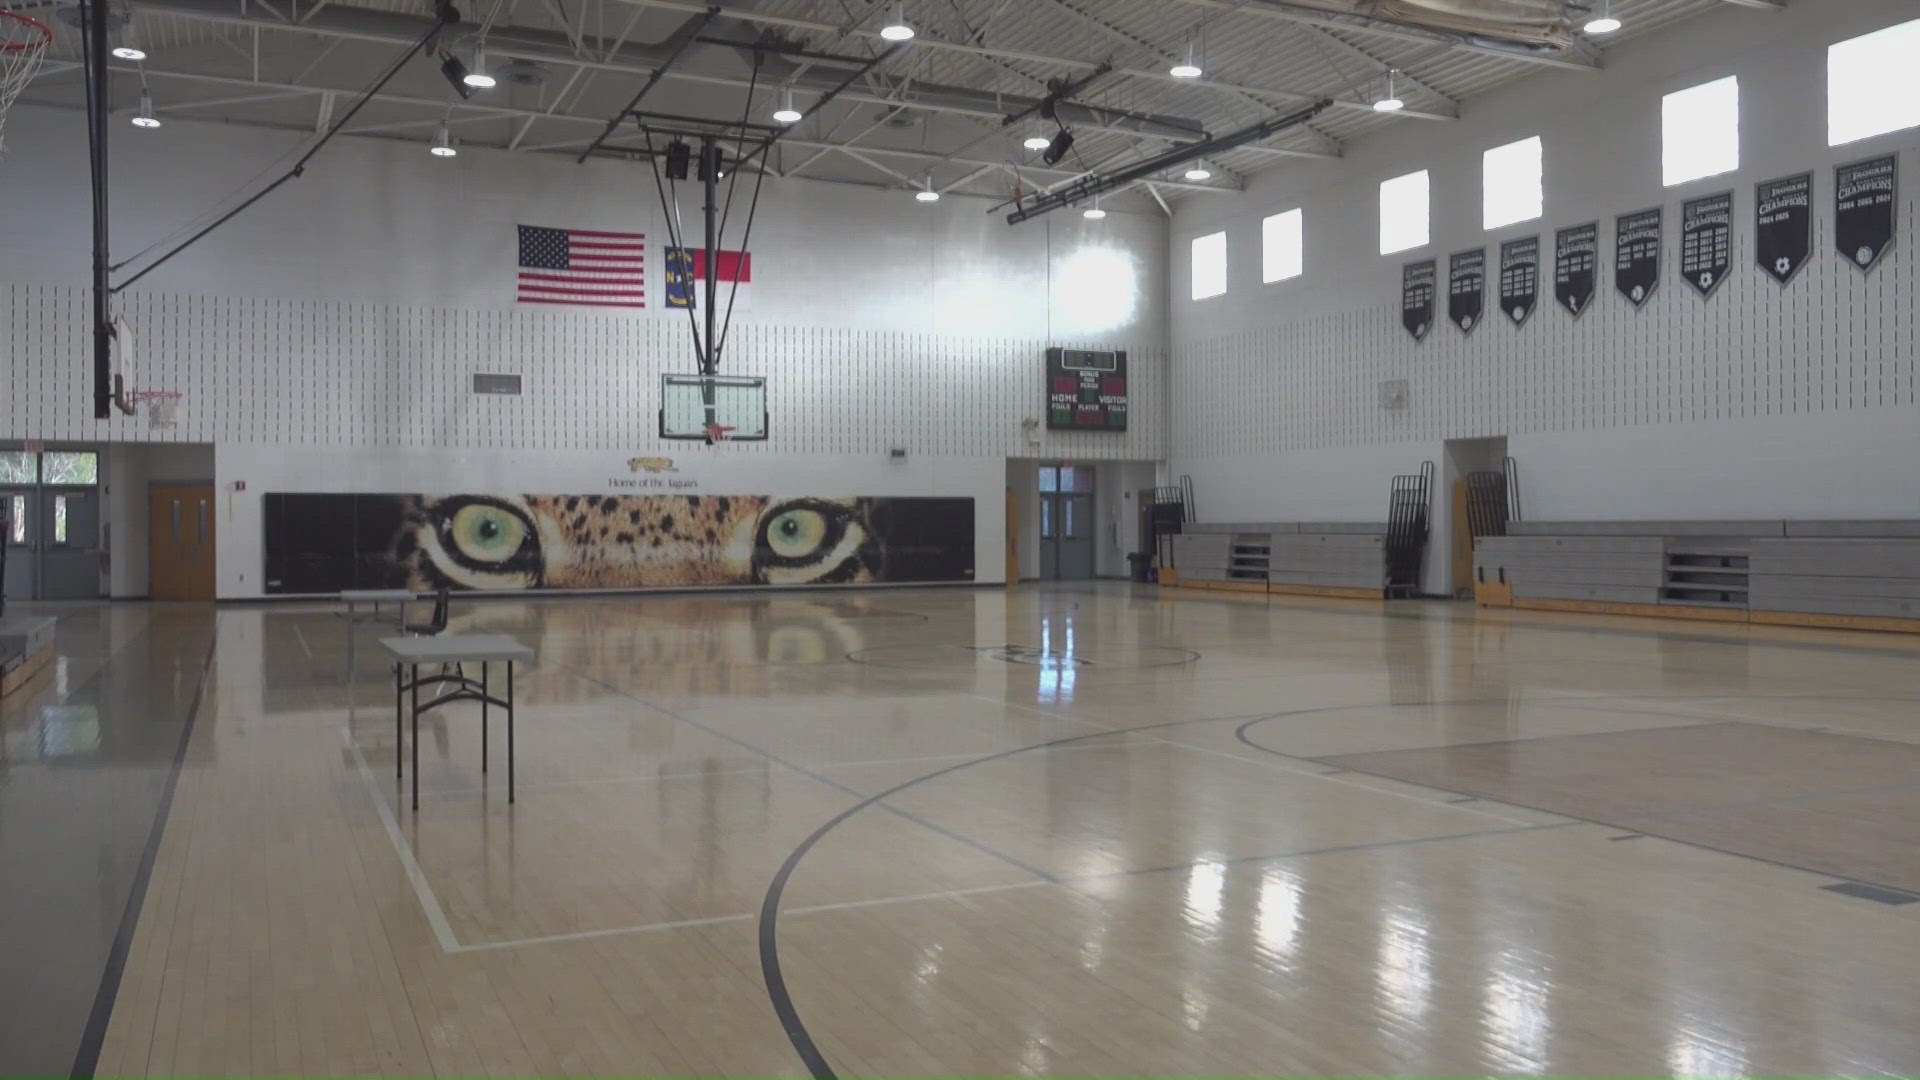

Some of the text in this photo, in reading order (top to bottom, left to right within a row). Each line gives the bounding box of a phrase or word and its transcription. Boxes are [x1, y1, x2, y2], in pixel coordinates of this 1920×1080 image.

[1838, 179, 1892, 200] CHAMPIONS
[1759, 195, 1808, 215] CHAMPIONS
[666, 271, 675, 284] N
[1051, 393, 1078, 403] HOME
[1098, 395, 1127, 404] VISITOR
[608, 477, 637, 488] Home
[639, 477, 648, 488] of
[668, 477, 699, 489] Jaguars
